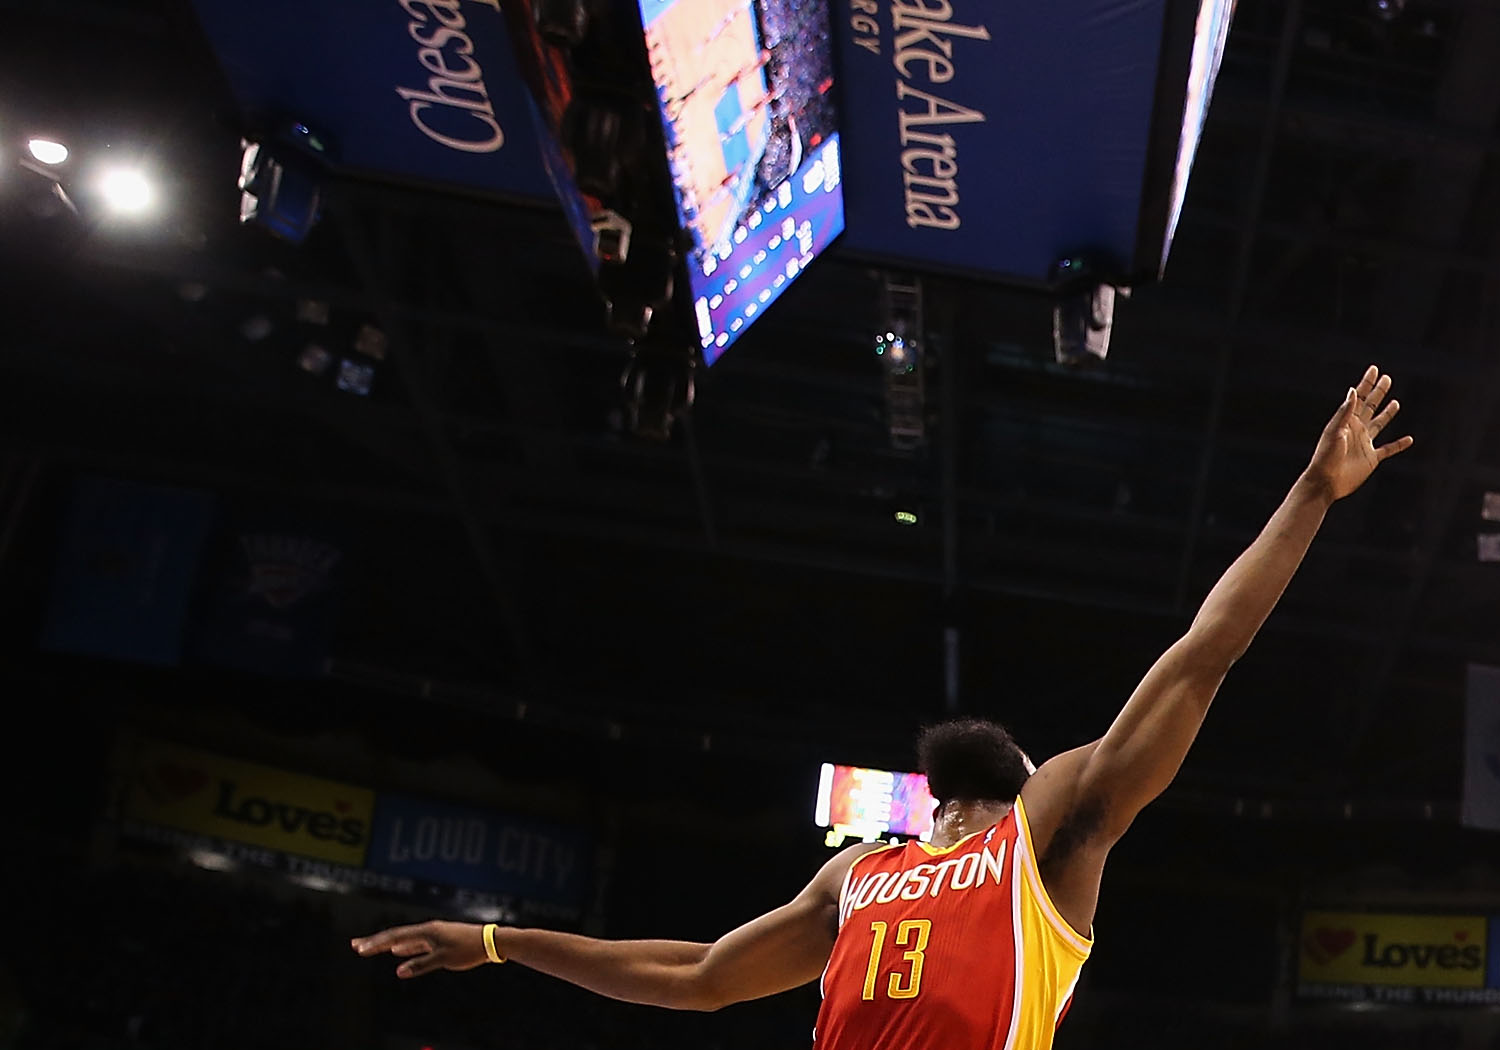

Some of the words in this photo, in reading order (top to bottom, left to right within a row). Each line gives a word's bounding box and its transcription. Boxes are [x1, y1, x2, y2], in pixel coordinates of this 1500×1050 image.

[396, 0, 505, 154] Chesa
[896, 79, 987, 231] Arena
[387, 815, 488, 866] LOUD
[497, 826, 578, 891] CITY
[844, 839, 1008, 921] HOUSTON
[861, 918, 932, 1001] 13
